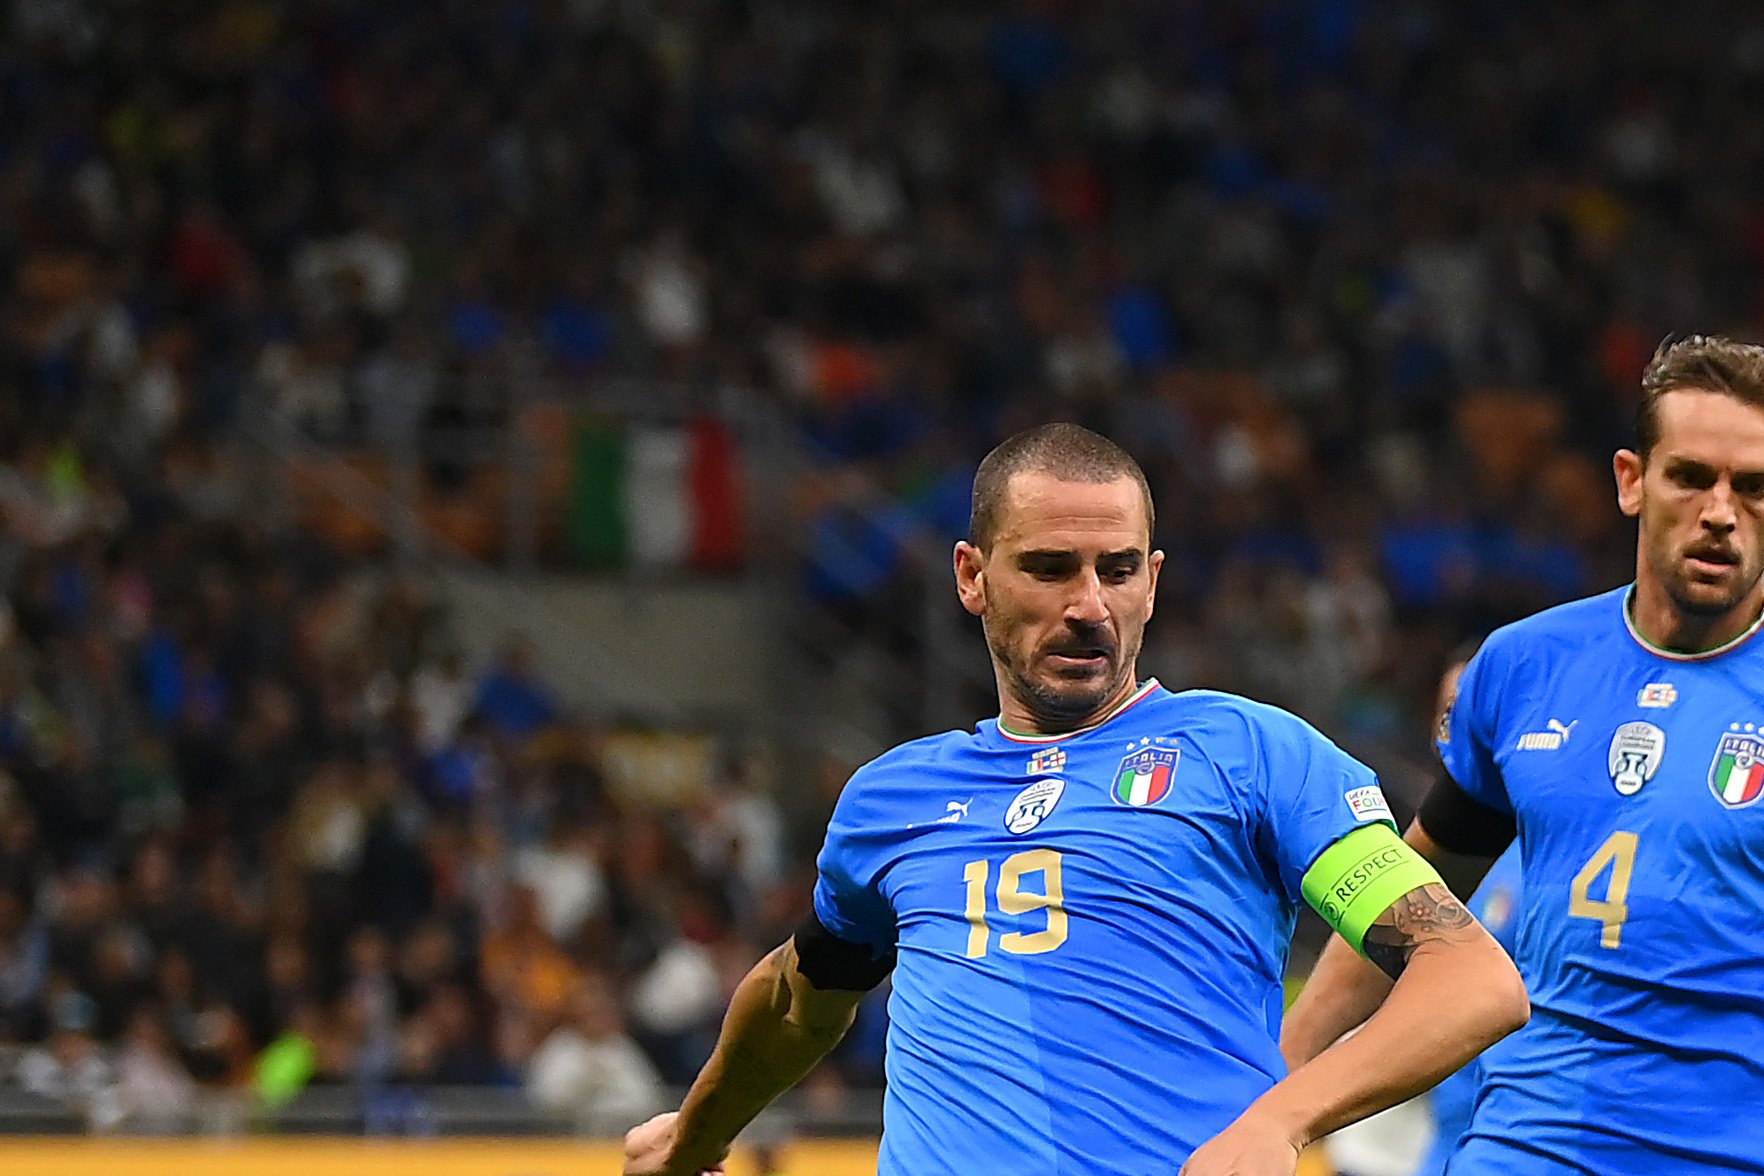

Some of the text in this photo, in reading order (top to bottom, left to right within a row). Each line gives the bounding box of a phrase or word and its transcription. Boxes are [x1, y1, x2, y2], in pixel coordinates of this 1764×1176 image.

[1353, 796, 1386, 811] FOU
[963, 848, 1068, 959] 19
[1336, 848, 1403, 903] RESPECT
[1568, 830, 1639, 949] 4
